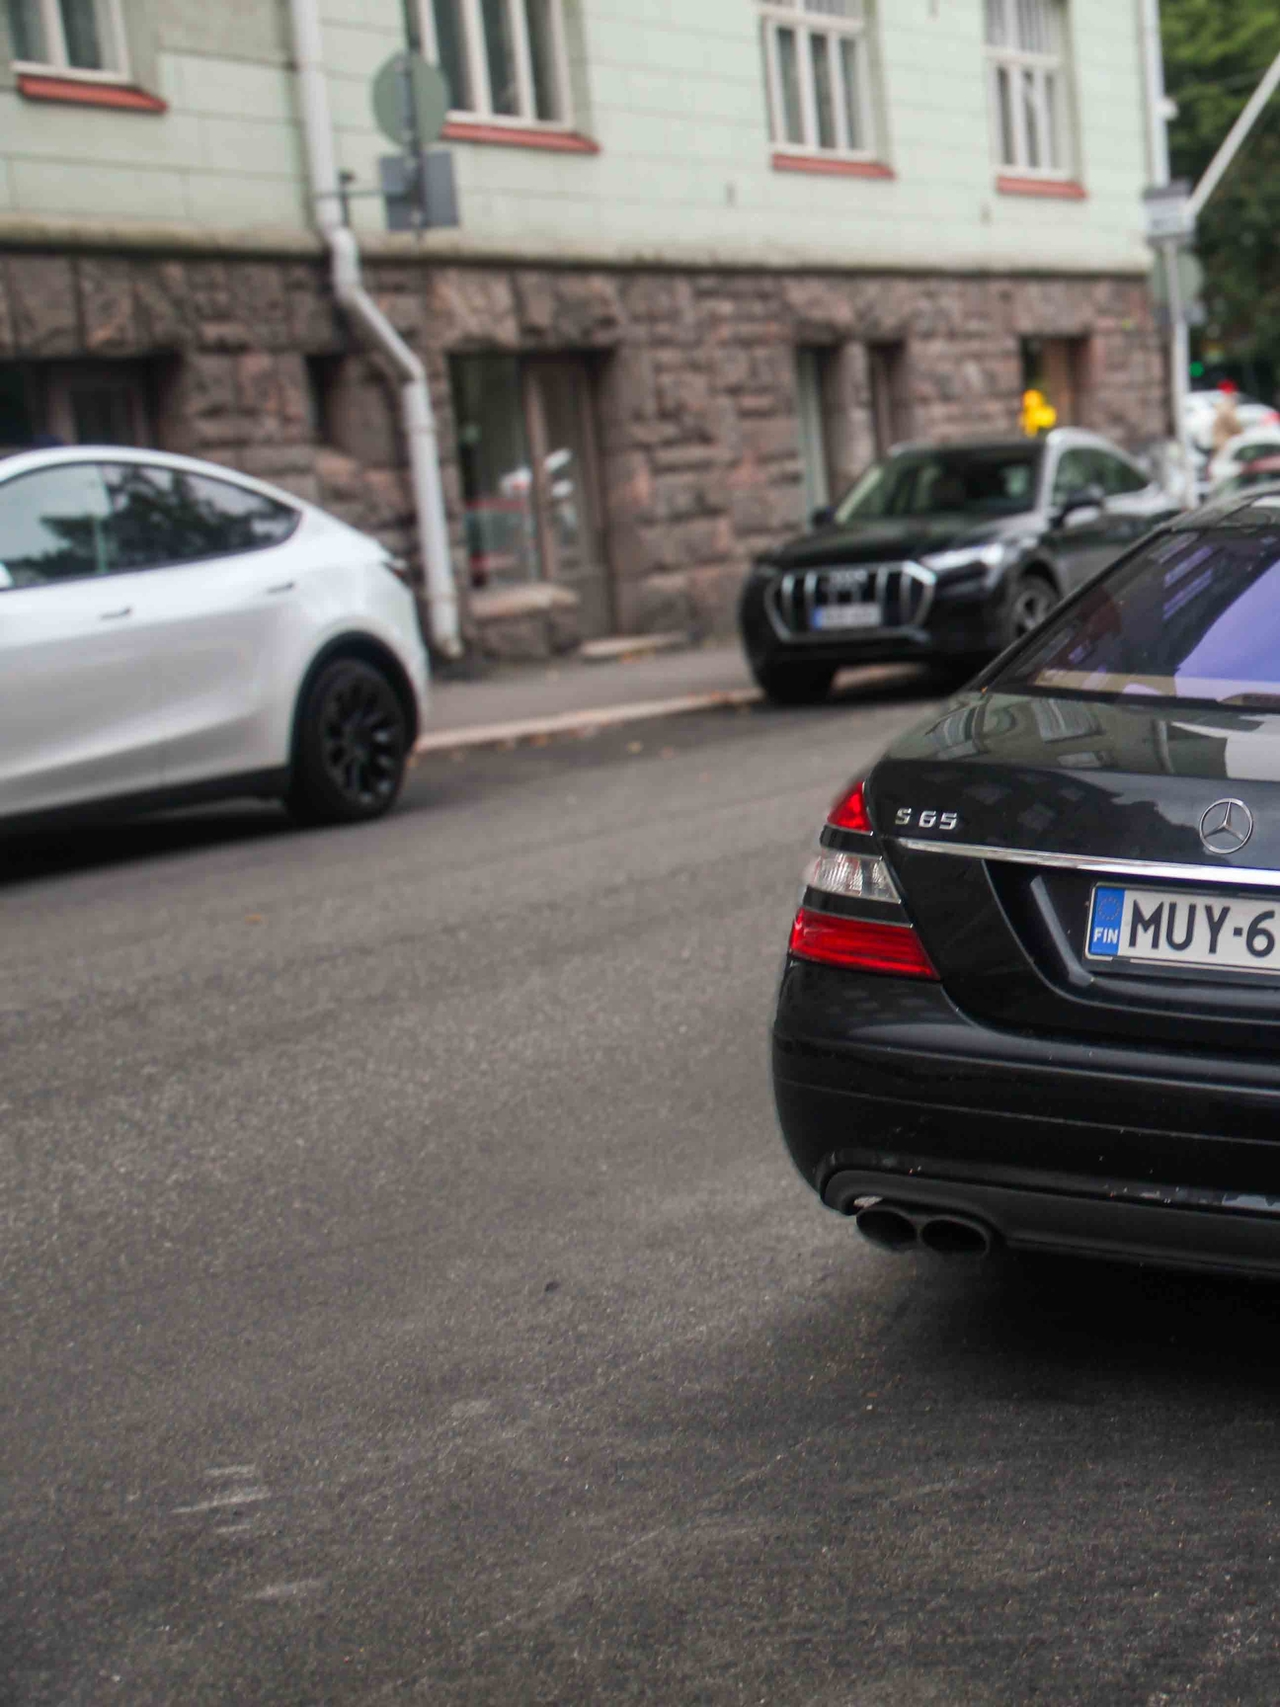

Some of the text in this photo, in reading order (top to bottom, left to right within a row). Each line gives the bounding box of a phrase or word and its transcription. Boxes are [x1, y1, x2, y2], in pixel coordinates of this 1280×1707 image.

[895, 808, 957, 830] S 65
[1093, 927, 1117, 944] FIN
